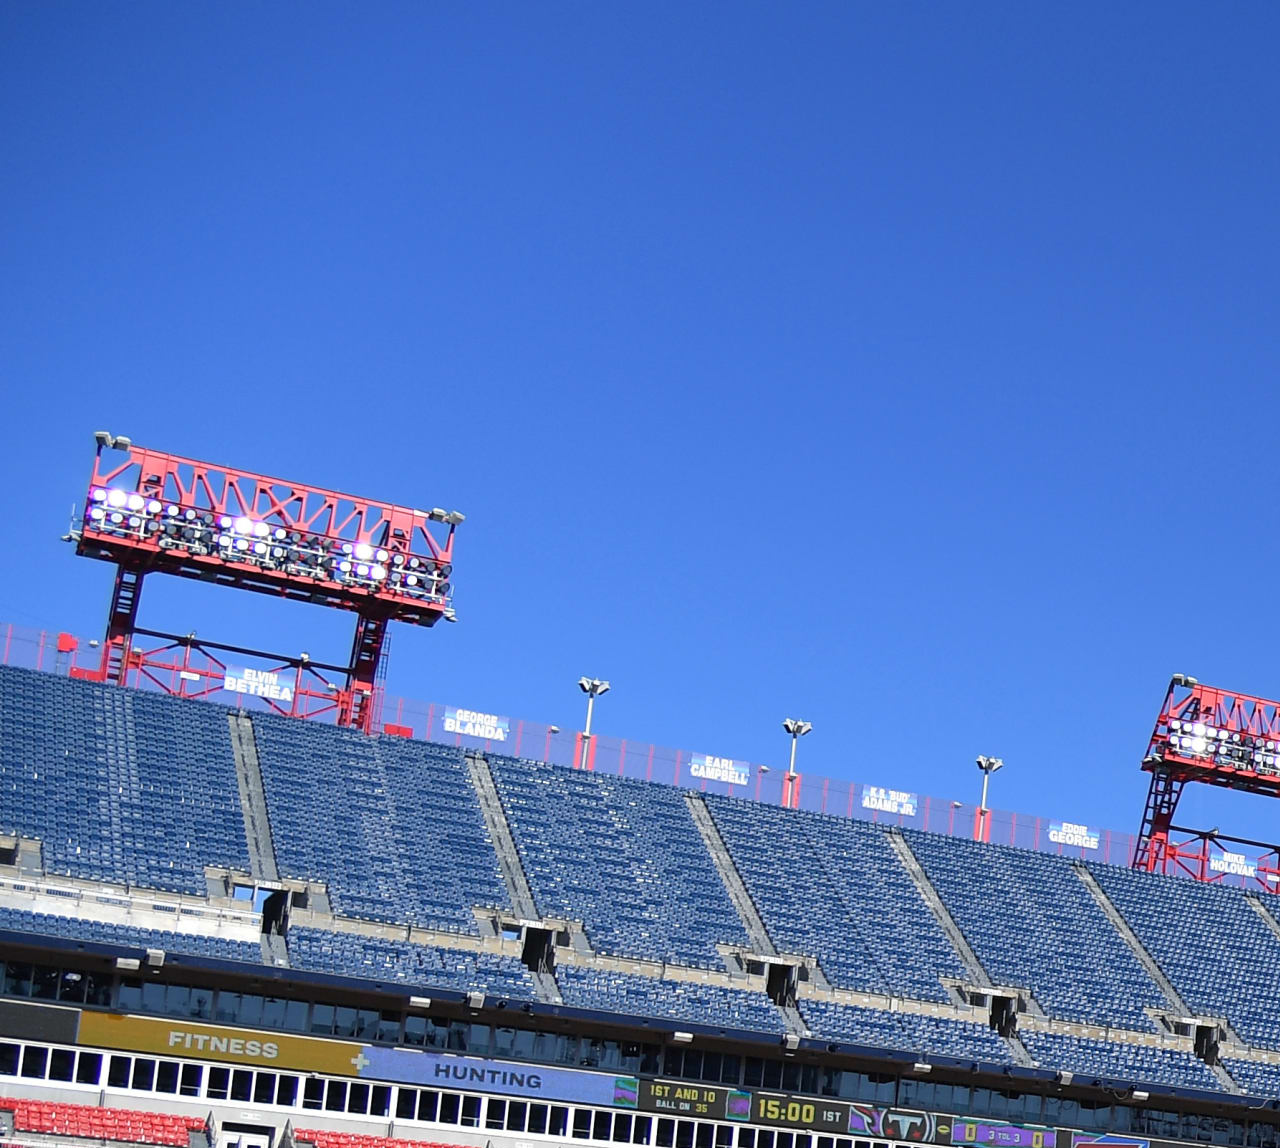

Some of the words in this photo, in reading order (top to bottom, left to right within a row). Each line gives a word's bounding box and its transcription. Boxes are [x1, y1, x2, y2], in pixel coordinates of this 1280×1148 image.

[242, 668, 279, 684] ELVIN
[223, 677, 293, 702] BETHEA
[455, 709, 499, 727] GEORGE
[444, 719, 508, 741] BLANDA
[704, 755, 735, 771] EARL
[689, 764, 748, 785] CAMPBELL
[861, 796, 899, 814] ADAMS
[1061, 822, 1088, 836] EDDIE
[1048, 831, 1099, 849] GEORGE
[1223, 851, 1246, 864] MIKE
[1209, 858, 1257, 877] HOLOVAK
[167, 1030, 279, 1059] FITNESS
[434, 1063, 542, 1089] HUNTING
[650, 1084, 671, 1098] 1ST
[674, 1087, 699, 1101] AND
[703, 1091, 716, 1103] 10
[656, 1100, 677, 1111] BALL
[679, 1102, 691, 1111] ON
[695, 1103, 709, 1113] 35
[758, 1098, 816, 1123] 15:00
[822, 1110, 843, 1123] 1ST
